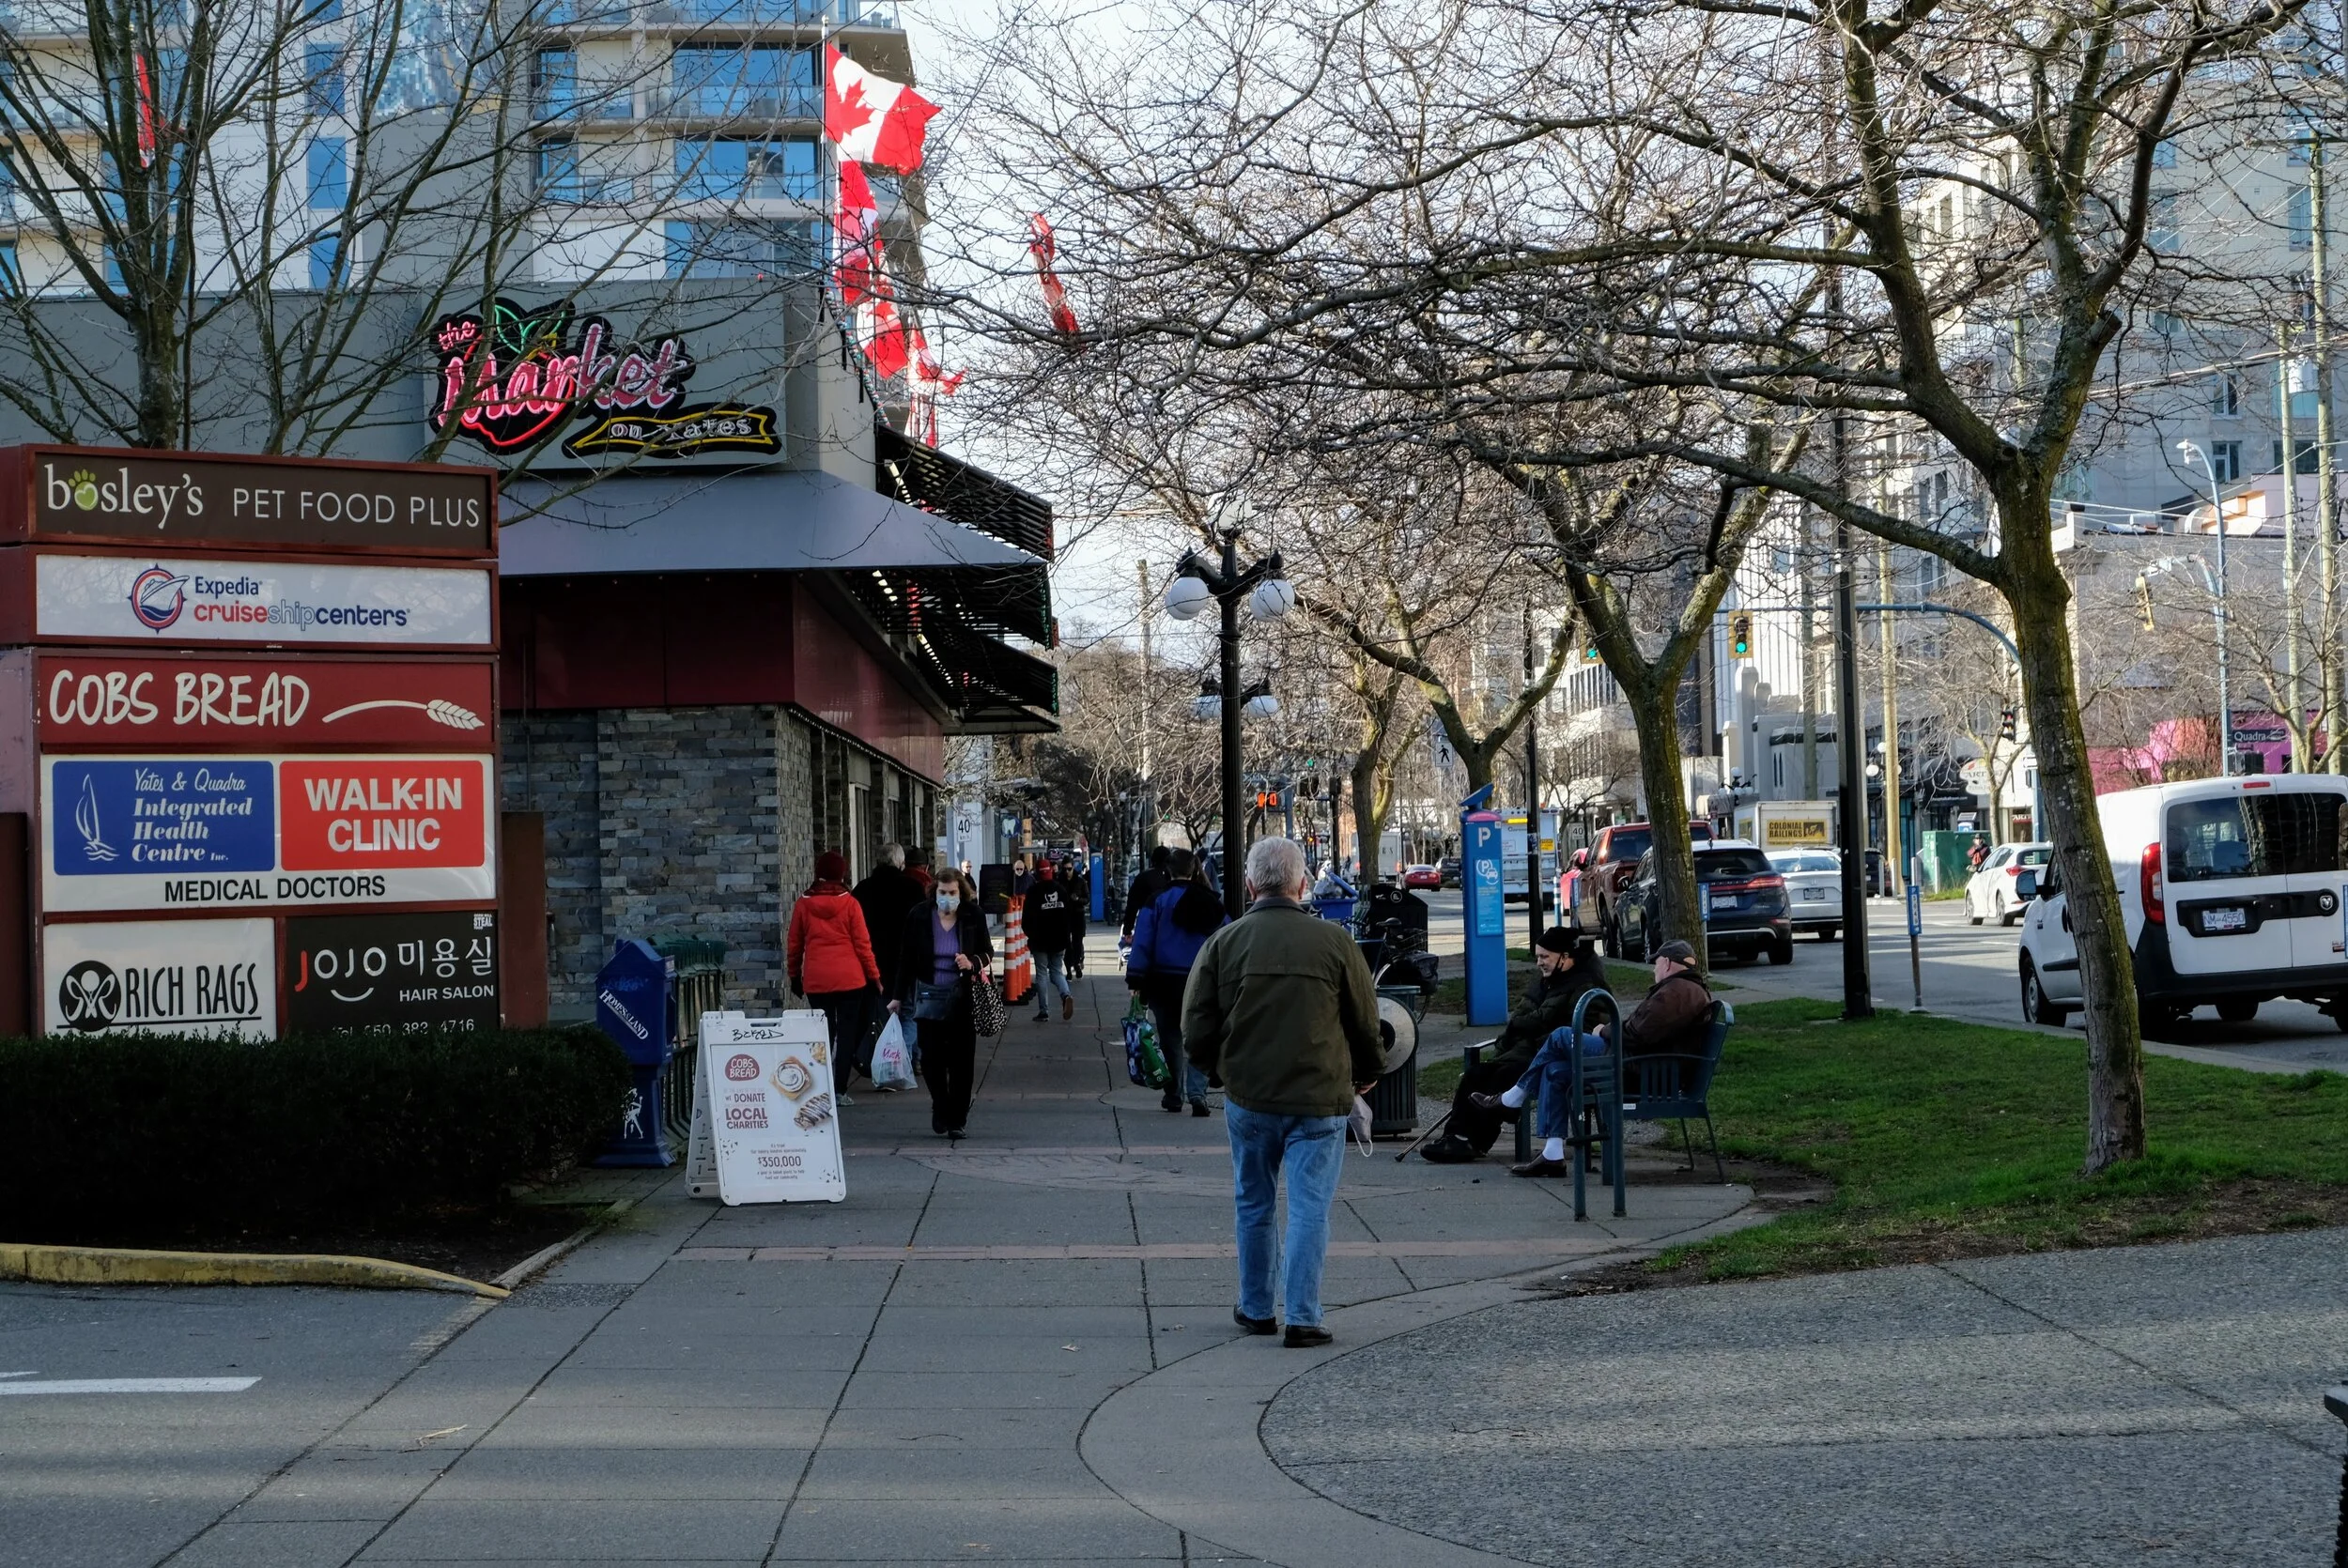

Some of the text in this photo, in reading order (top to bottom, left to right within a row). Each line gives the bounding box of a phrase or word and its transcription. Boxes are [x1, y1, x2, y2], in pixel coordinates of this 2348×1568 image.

[439, 321, 476, 350] the
[438, 323, 687, 429] Market
[611, 423, 642, 440] on
[44, 464, 481, 530] bosley's PET FOOD PLUS
[194, 576, 260, 596] Expedia
[49, 669, 310, 728] COBS BREAD
[2234, 731, 2265, 742] Quadra
[134, 768, 246, 792] Yates & Quadra
[303, 777, 462, 812] WALK-IN
[132, 796, 252, 822] Integrated
[133, 821, 209, 841] Health
[327, 818, 440, 853] CLINIC
[958, 820, 970, 833] 40
[131, 843, 228, 862] Centre Inc.
[165, 875, 386, 902] MEDICAL DOCTORS
[397, 936, 492, 978] 미용실
[295, 946, 387, 992] JOJO
[126, 962, 259, 1018] RICH RAGS
[399, 985, 494, 1002] HAIR SALON
[332, 1025, 353, 1038] el
[440, 1019, 474, 1034] 4716
[730, 1068, 756, 1078] BREAD
[731, 1058, 753, 1068] COBS
[734, 1093, 765, 1102] DONATE
[725, 1108, 767, 1120] LOCAL
[727, 1120, 768, 1130] CHARITIES
[758, 1156, 801, 1167] $350,000
